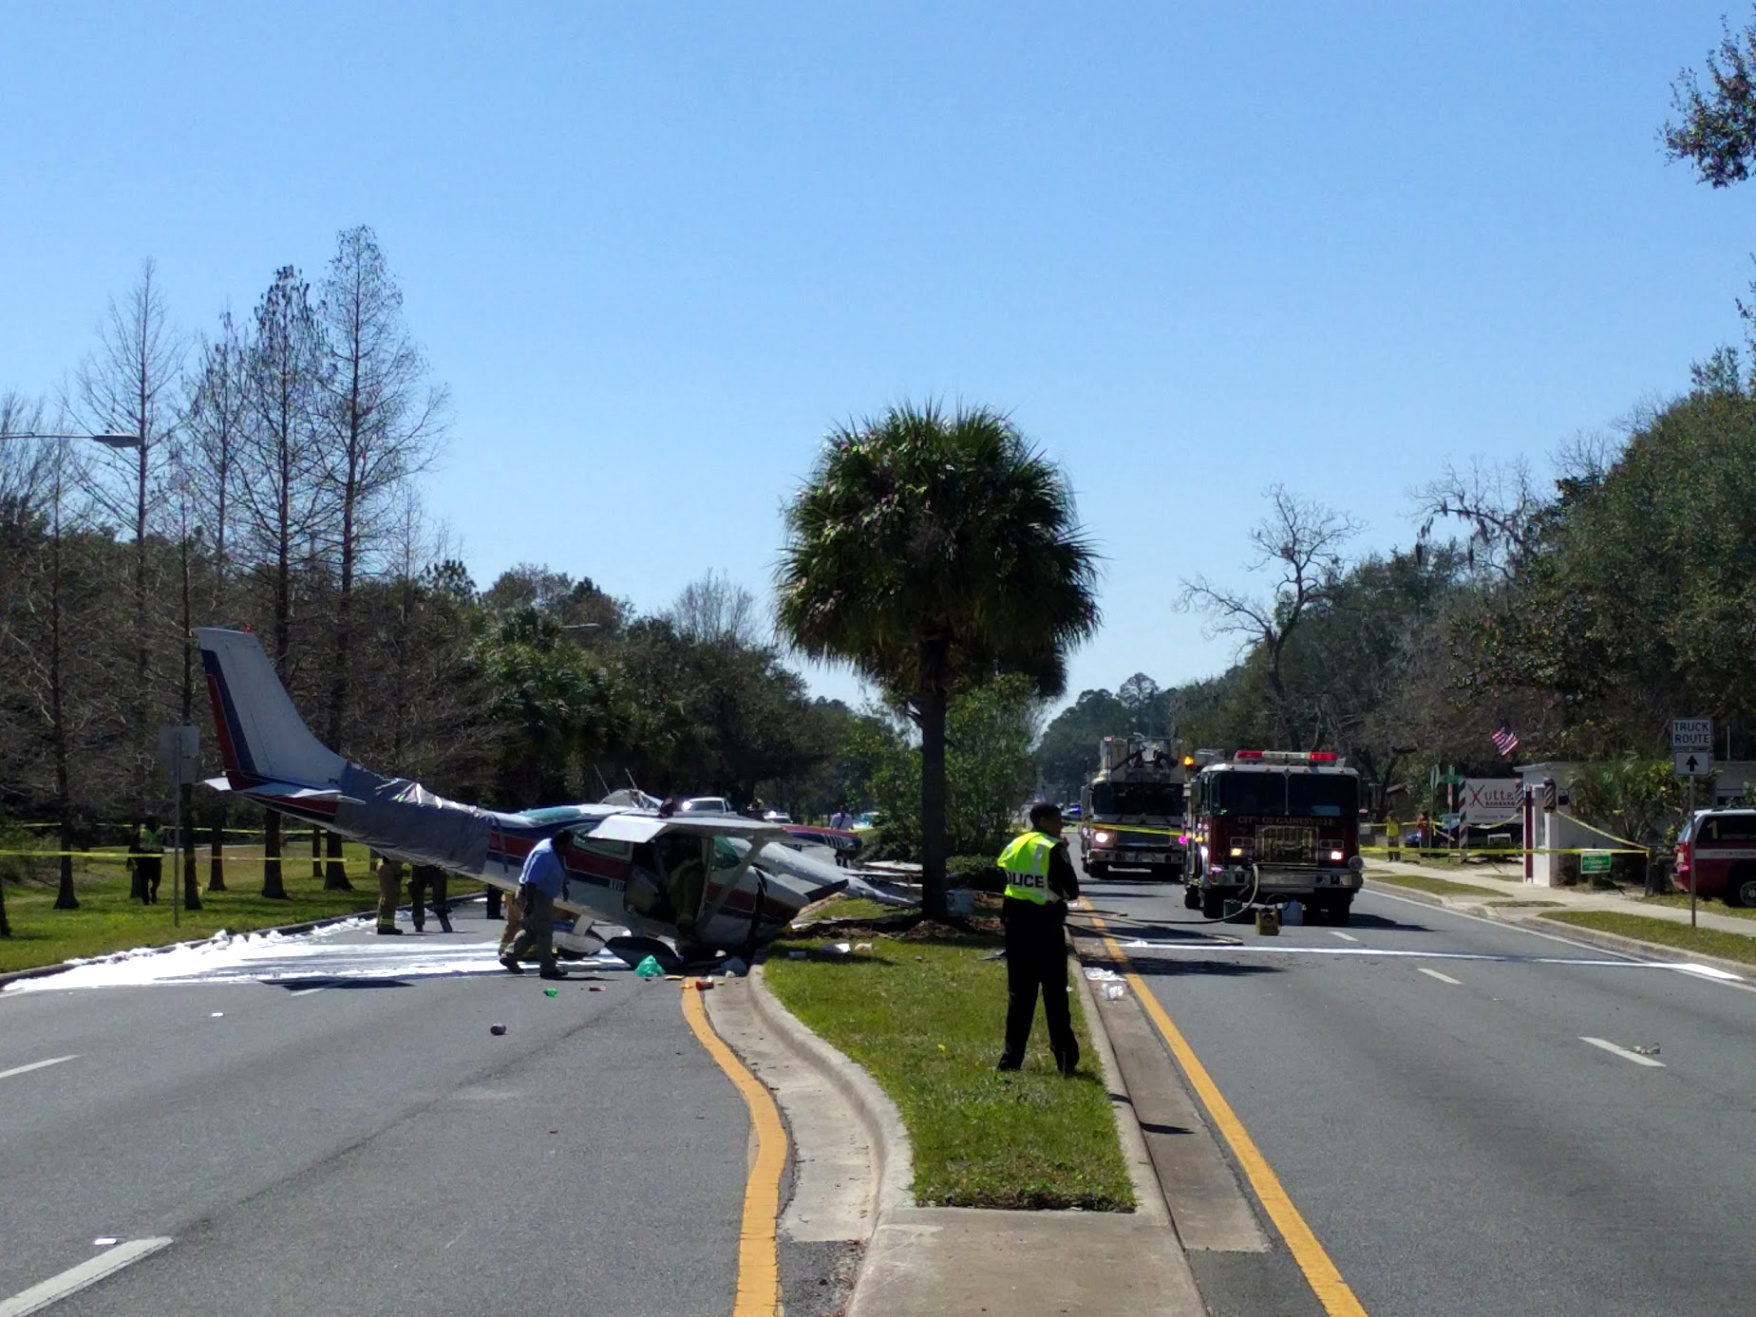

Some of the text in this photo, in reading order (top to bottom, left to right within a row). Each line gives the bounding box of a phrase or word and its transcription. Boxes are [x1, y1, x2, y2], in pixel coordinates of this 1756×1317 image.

[1674, 722, 1709, 732] TRUCK
[1675, 733, 1710, 744] ROUTE
[1706, 820, 1718, 839] 1
